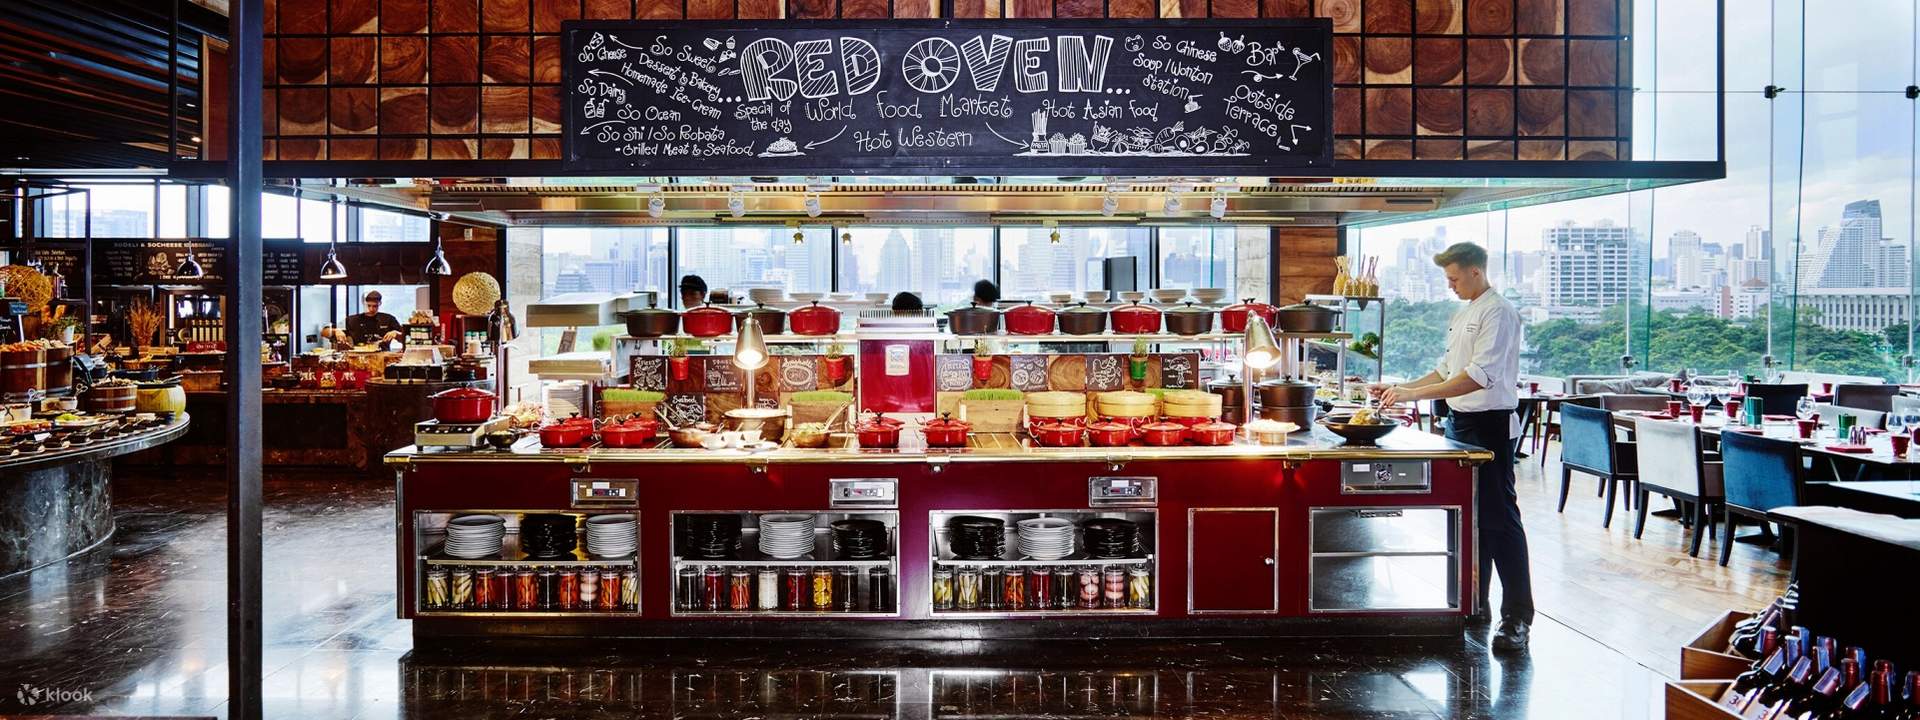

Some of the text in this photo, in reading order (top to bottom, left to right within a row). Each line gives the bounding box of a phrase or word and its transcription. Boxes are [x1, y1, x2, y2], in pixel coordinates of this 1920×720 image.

[578, 45, 628, 63] So Cheese
[650, 35, 717, 74] So Sweet
[1152, 34, 1218, 63] So Chinese
[639, 52, 682, 81] Dessert
[678, 73, 689, 86] &
[1132, 52, 1163, 75] Soup
[578, 78, 627, 104] So Dairy
[621, 62, 668, 95] Homemade
[1142, 74, 1190, 101] Station
[617, 103, 681, 122] So Ocean
[734, 100, 792, 120] Special of
[804, 97, 857, 122] World
[939, 93, 1015, 119] Market
[1042, 98, 1076, 120] Hot
[1082, 98, 1123, 120] Asian
[1235, 84, 1296, 121] Outside
[750, 117, 793, 134] the day
[1223, 95, 1278, 137] Terrace
[597, 125, 620, 143] So
[679, 124, 725, 142] Robata
[853, 125, 973, 152] Hot Western
[663, 143, 690, 156] Meat
[692, 145, 701, 156] &
[703, 139, 756, 157] Seafood
